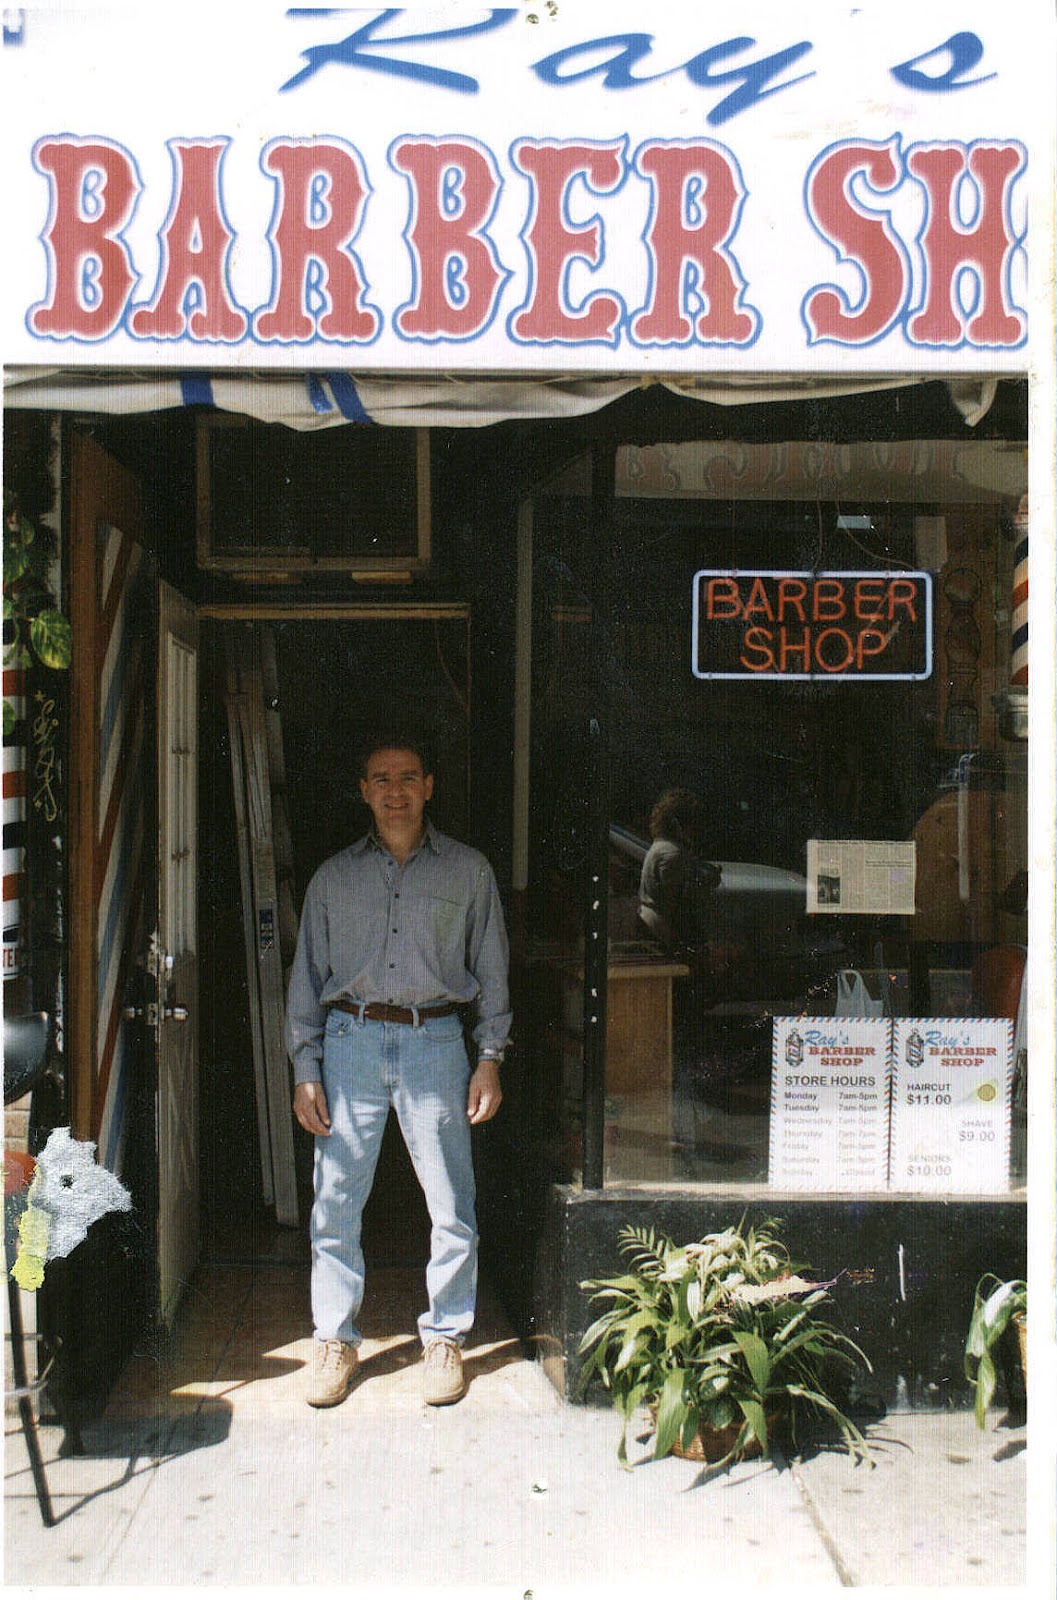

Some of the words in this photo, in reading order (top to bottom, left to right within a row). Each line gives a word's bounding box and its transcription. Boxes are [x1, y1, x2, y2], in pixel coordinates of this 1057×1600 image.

[278, 8, 998, 126] Rays
[26, 132, 762, 348] BARBER
[800, 131, 1028, 351] SH
[706, 577, 918, 622] BARBER
[740, 626, 887, 672] SHOP
[804, 1030, 848, 1048] Ray's
[925, 1030, 970, 1048] Ray's
[808, 1046, 876, 1056] BARBER
[928, 1047, 997, 1056] BARBER
[820, 1057, 863, 1066] SHOP
[940, 1058, 984, 1067] SHOP
[785, 1075, 827, 1086] STORE
[831, 1075, 876, 1086] HOURS
[907, 1083, 951, 1091] HAIRCUT
[784, 1092, 817, 1100] Monday
[839, 1092, 878, 1100] 7am-5pm
[907, 1093, 951, 1105] $11.00
[784, 1104, 819, 1112] Tuesday
[961, 1120, 993, 1128] SHAVE
[907, 1165, 951, 1177] $10.00
